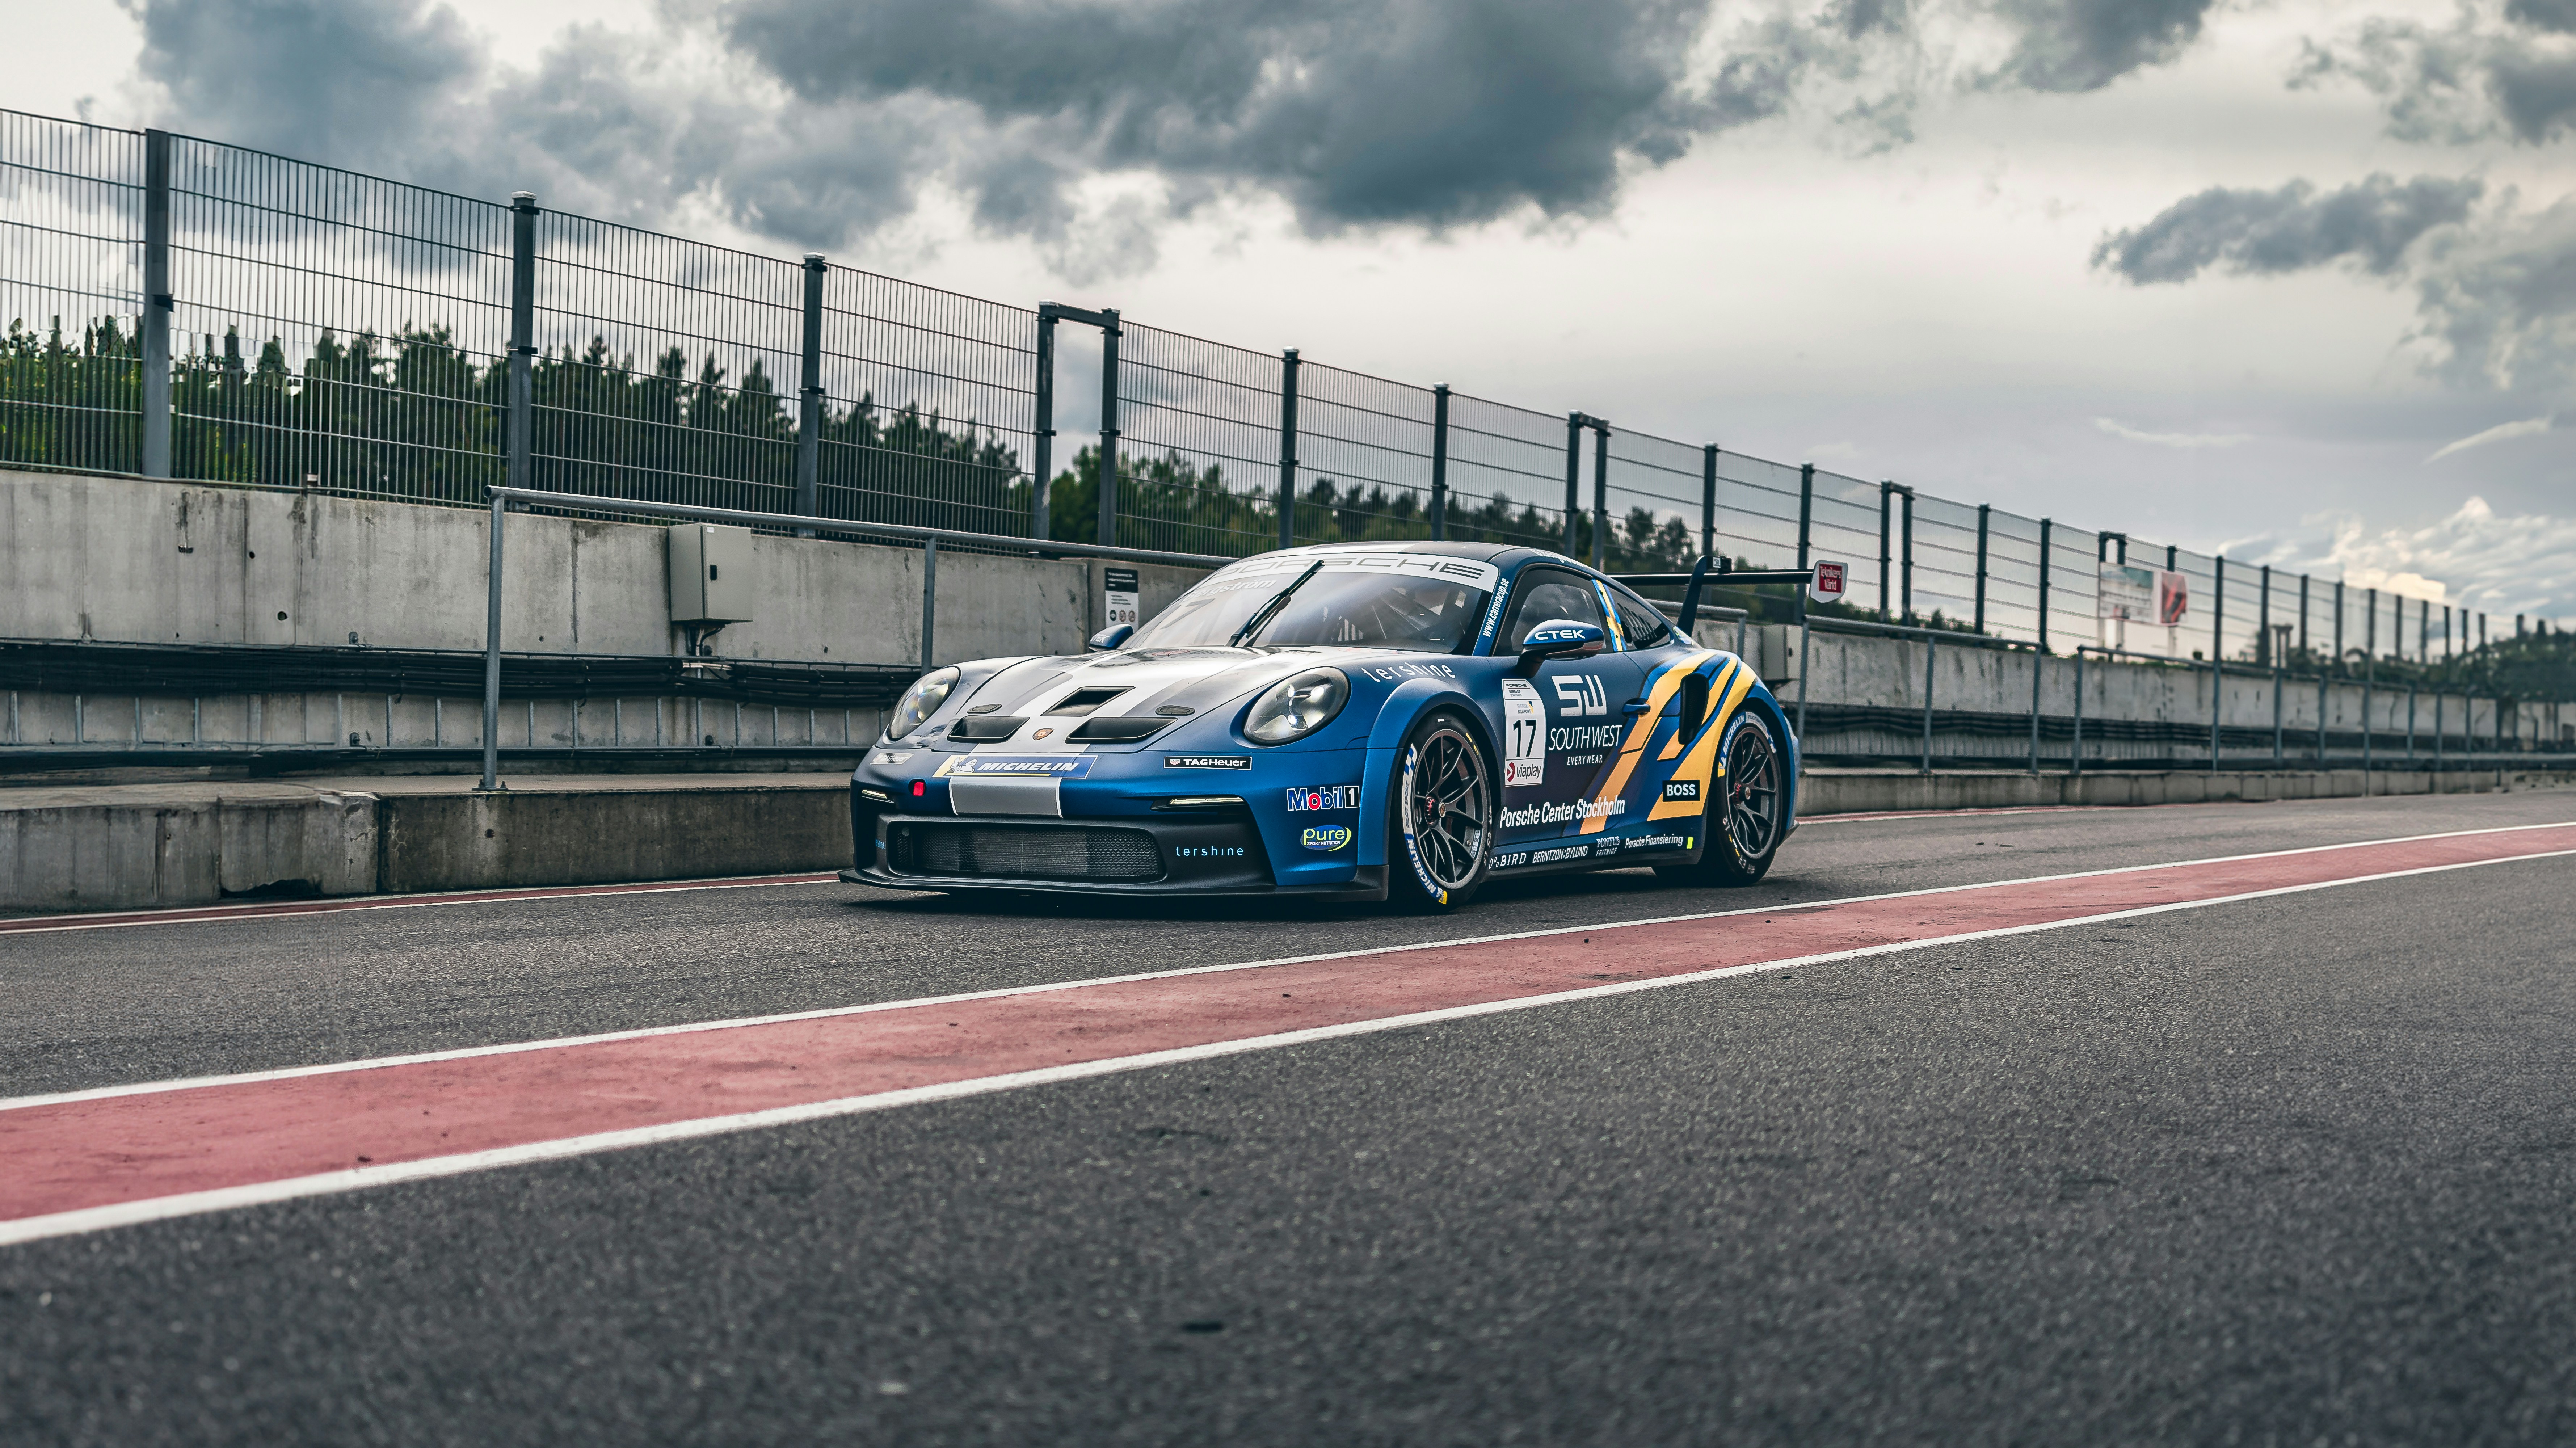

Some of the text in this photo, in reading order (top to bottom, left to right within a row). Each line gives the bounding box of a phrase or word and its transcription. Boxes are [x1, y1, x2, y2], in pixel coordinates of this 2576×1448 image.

[1211, 558, 1485, 580] PORSCHE
[1483, 578, 1509, 637] www.carreracup.se
[1535, 630, 1586, 640] CTEK
[1552, 675, 1607, 717] SW
[1513, 720, 1537, 757] 17
[1723, 714, 1744, 755] MICHELIN
[977, 763, 1079, 771] MICHELIN
[1567, 754, 1603, 766] EVERYWEAR
[1517, 763, 1541, 779] viaplay
[1287, 786, 1343, 811] Mobil
[1667, 784, 1696, 796] BOSS
[1500, 795, 1625, 828] Porsche Center Stockholm
[1596, 836, 1620, 848] PONTUS
[1625, 833, 1684, 849] Porsche Finansiering
[1596, 847, 1617, 856] FRITHIOF
[1407, 839, 1436, 893] MICHELIN
